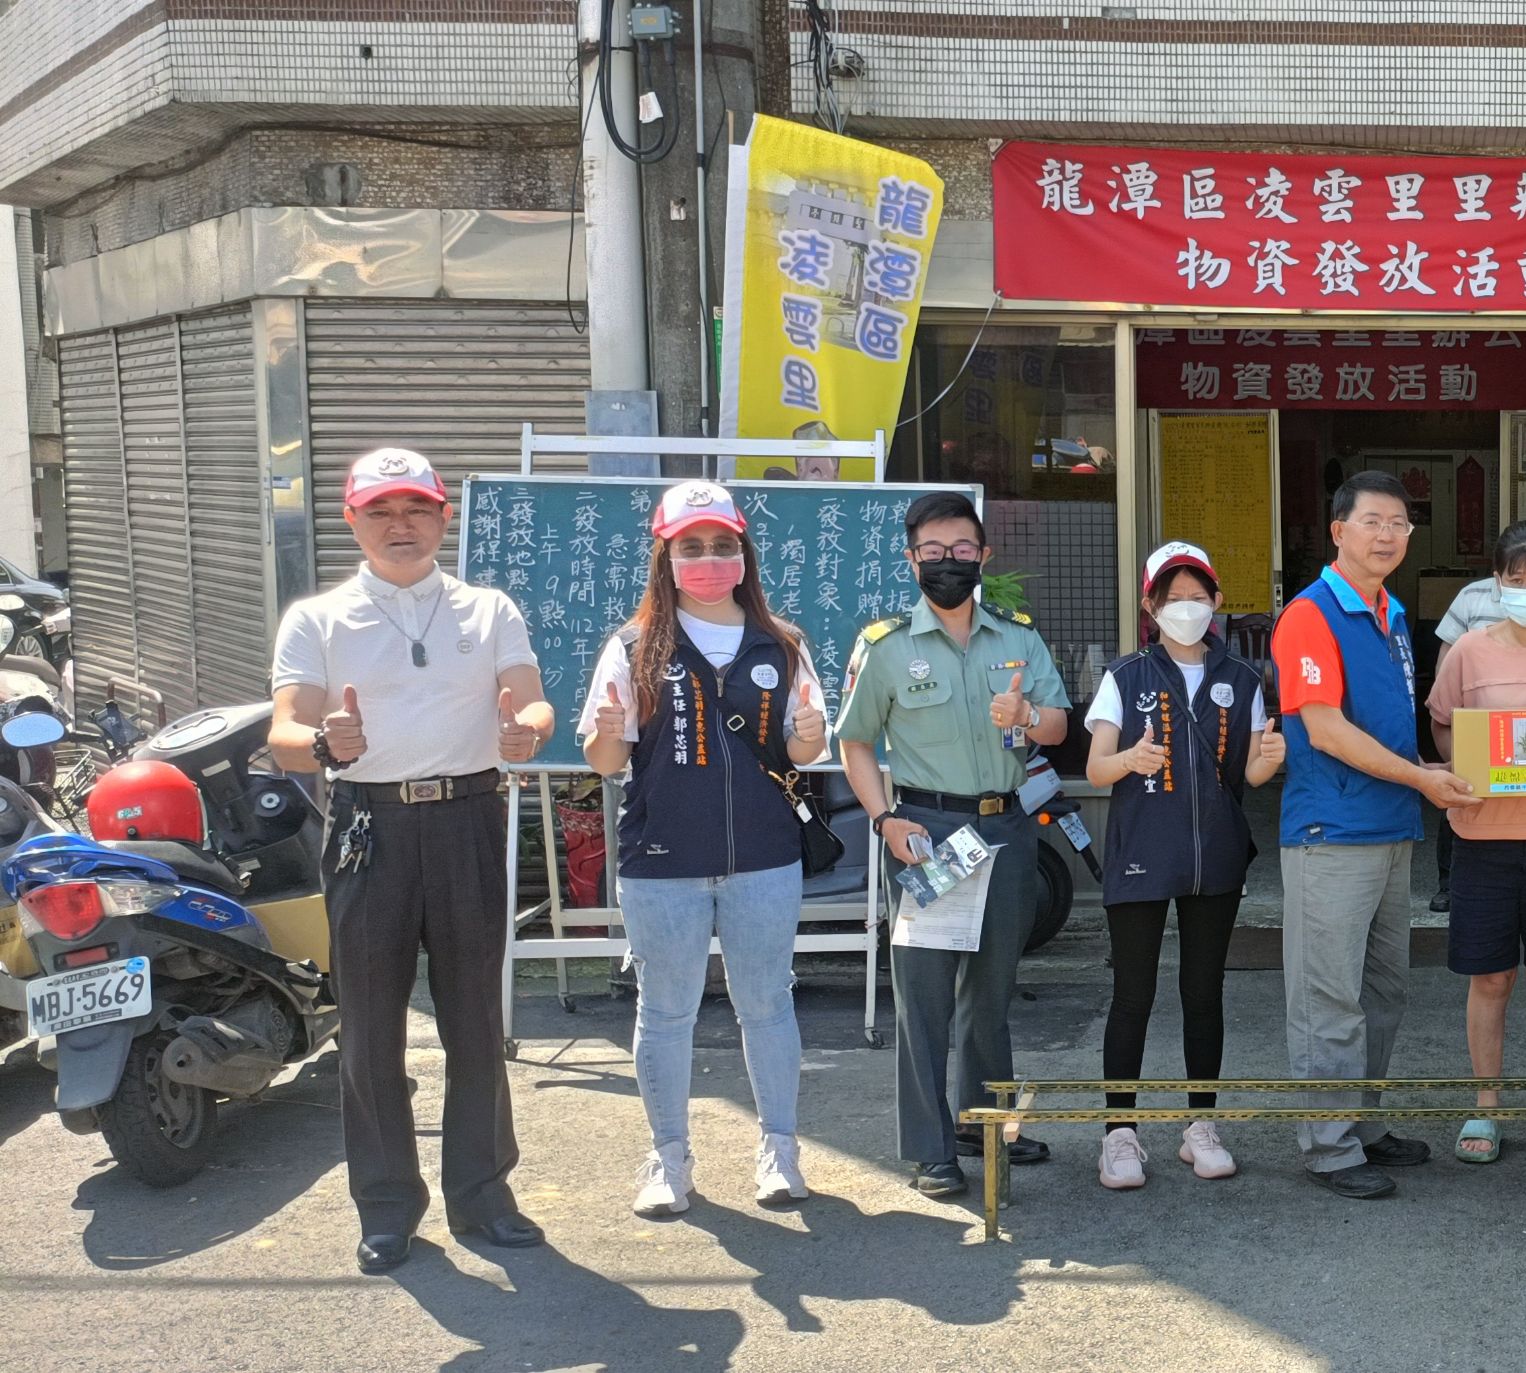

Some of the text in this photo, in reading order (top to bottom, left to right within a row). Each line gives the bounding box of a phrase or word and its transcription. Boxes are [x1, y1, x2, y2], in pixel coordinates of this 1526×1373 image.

[781, 231, 832, 411] 凌雲里
[860, 178, 931, 361] 龍潭區
[1180, 361, 1478, 402] 物資發放活動
[854, 499, 887, 621] 物資捐贈
